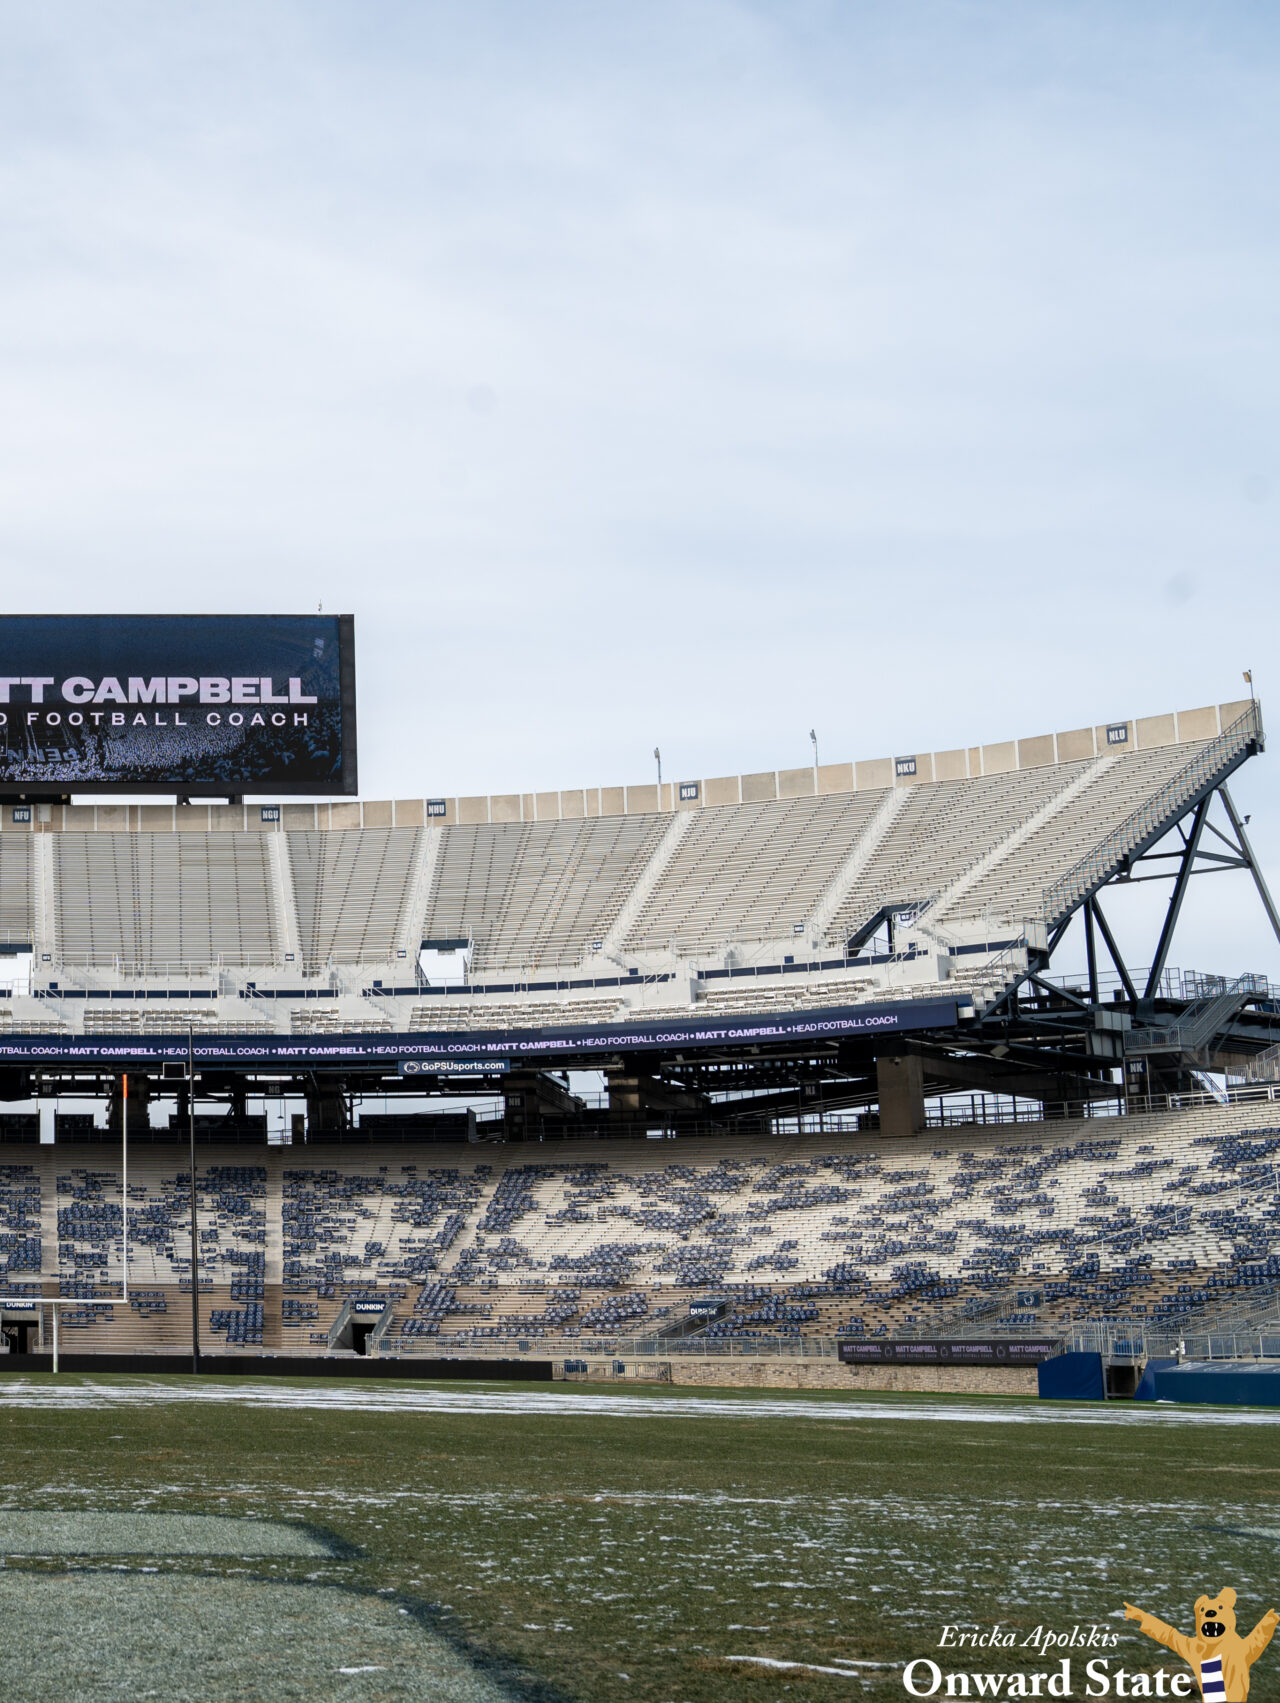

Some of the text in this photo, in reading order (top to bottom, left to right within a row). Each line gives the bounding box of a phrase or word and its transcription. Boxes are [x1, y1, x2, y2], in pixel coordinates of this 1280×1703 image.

[61, 676, 318, 704] CAMPBELL
[28, 713, 188, 726] FOOTBALL
[207, 713, 309, 726] COACH
[1109, 730, 1125, 742] NLU
[897, 762, 914, 773] NKU
[682, 788, 696, 798] NJU
[262, 810, 278, 819] NGU
[428, 805, 444, 814] NHU
[14, 811, 28, 820] NFU
[520, 1040, 576, 1049] CAMPBELL
[608, 1036, 655, 1044] FOOTBALL
[656, 1033, 689, 1041] COACH
[696, 1031, 728, 1039] MATT
[729, 1027, 786, 1037] CAMPBELL
[792, 1024, 818, 1032] HEAD
[818, 1020, 864, 1030] FOOTBALL
[866, 1016, 898, 1025] COACH
[422, 1060, 505, 1073] GoPSUsports.com
